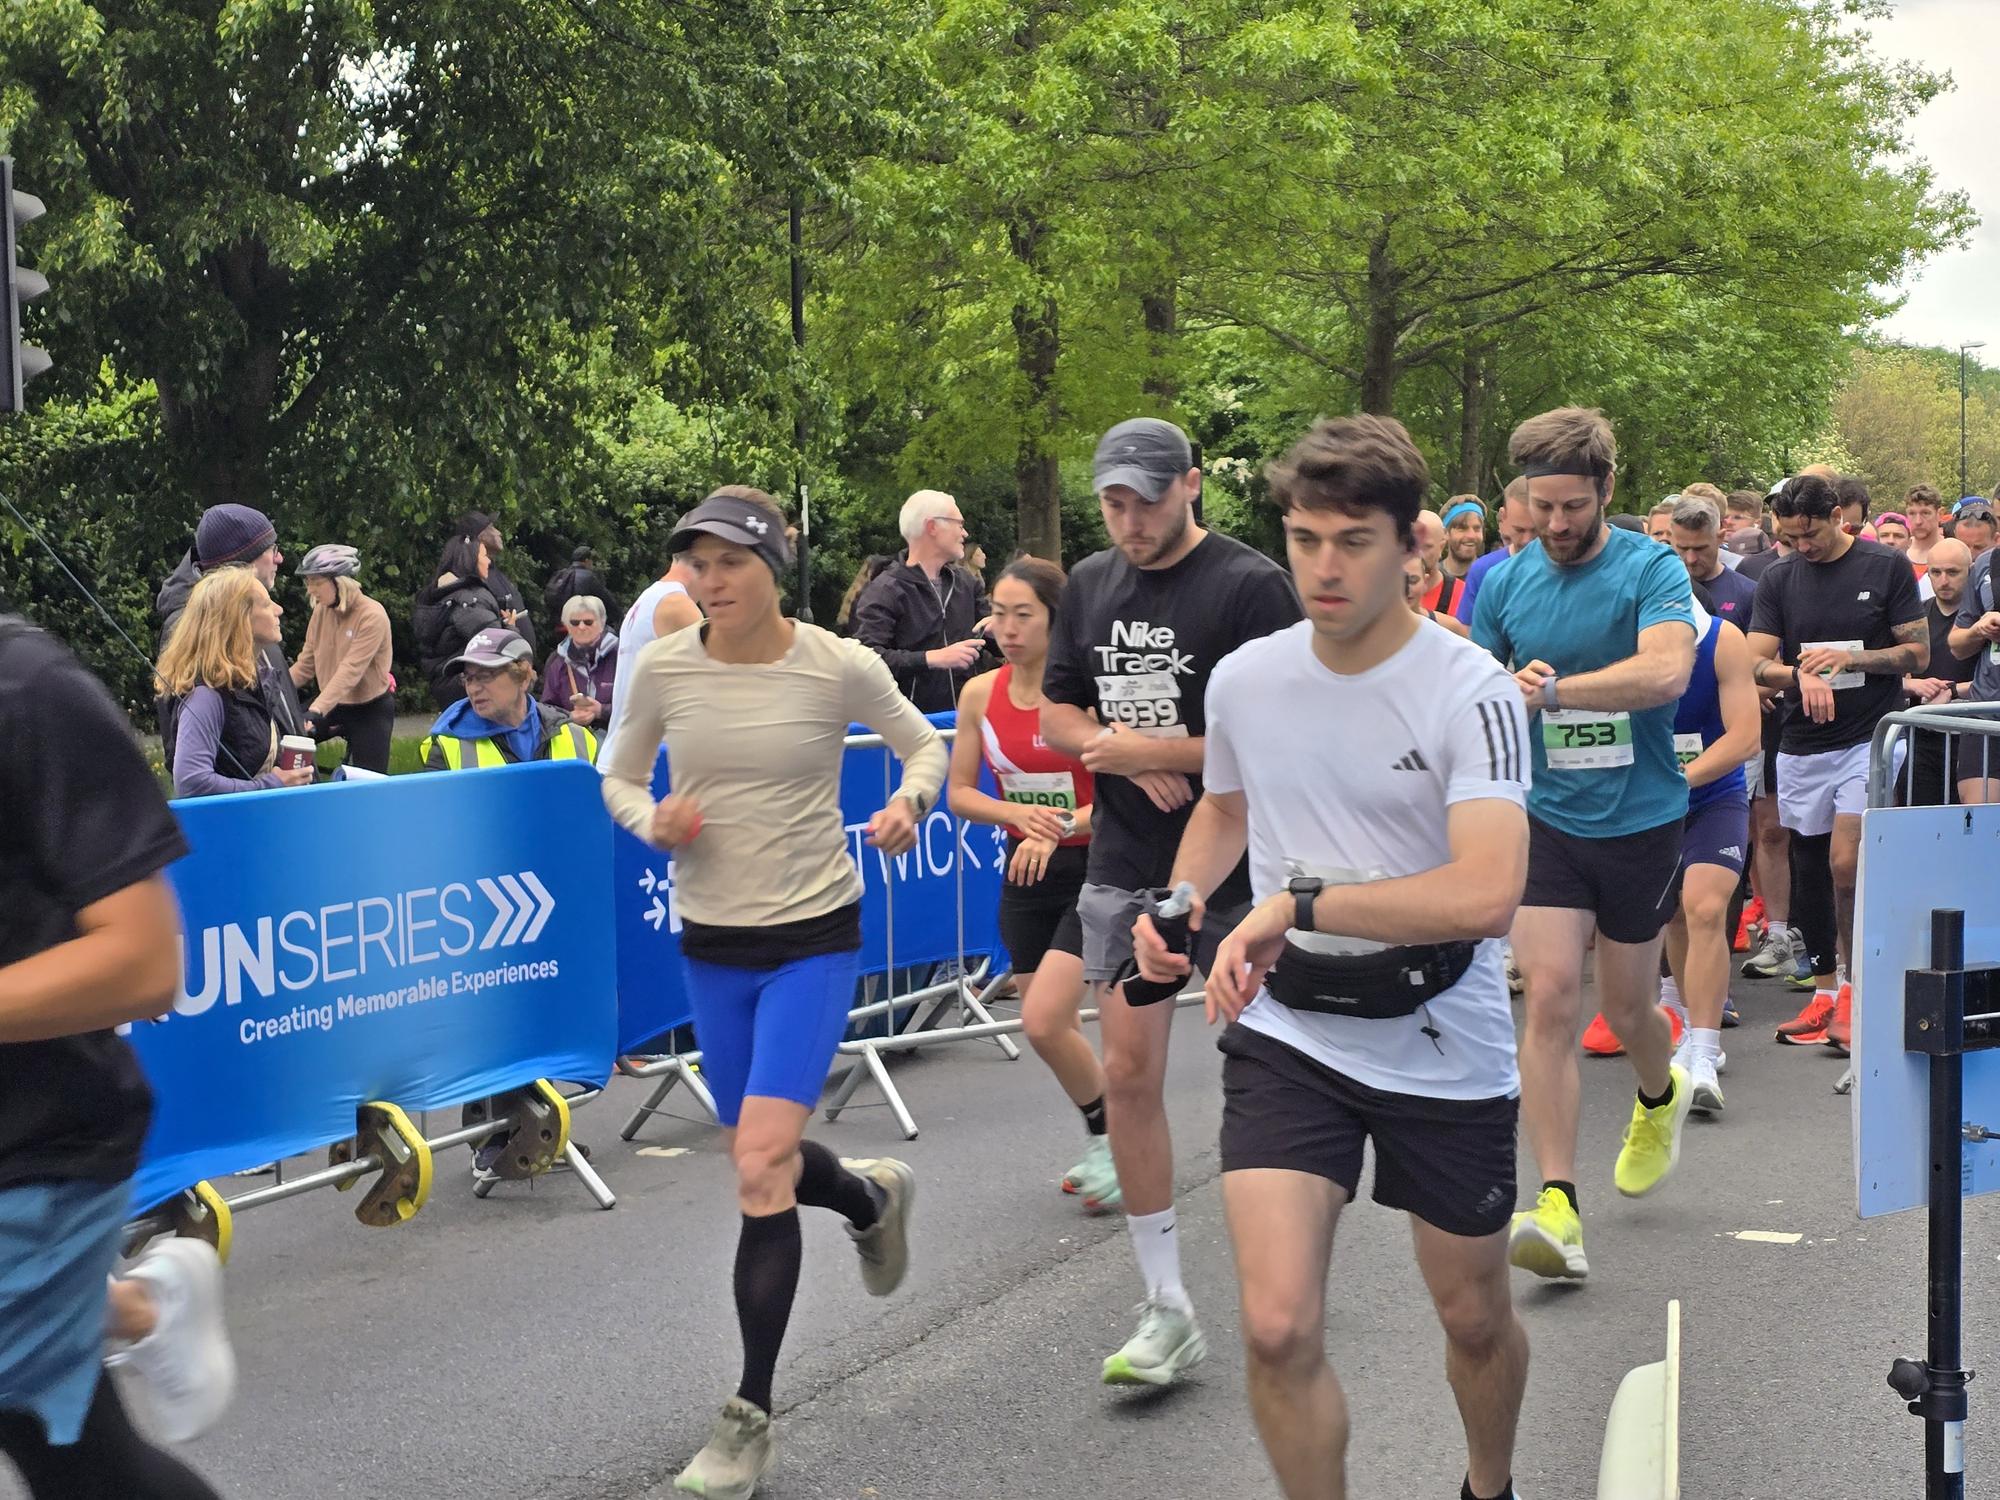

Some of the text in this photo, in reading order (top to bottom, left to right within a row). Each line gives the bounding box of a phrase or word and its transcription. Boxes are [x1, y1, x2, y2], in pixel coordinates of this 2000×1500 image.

[1111, 619, 1175, 649] Nike
[1094, 646, 1197, 675] Track
[1101, 698, 1178, 728] 4939
[1557, 722, 1616, 747] 753
[116, 882, 475, 1034] UNSERIES
[239, 959, 559, 1045] Creating Memorable Experiences
